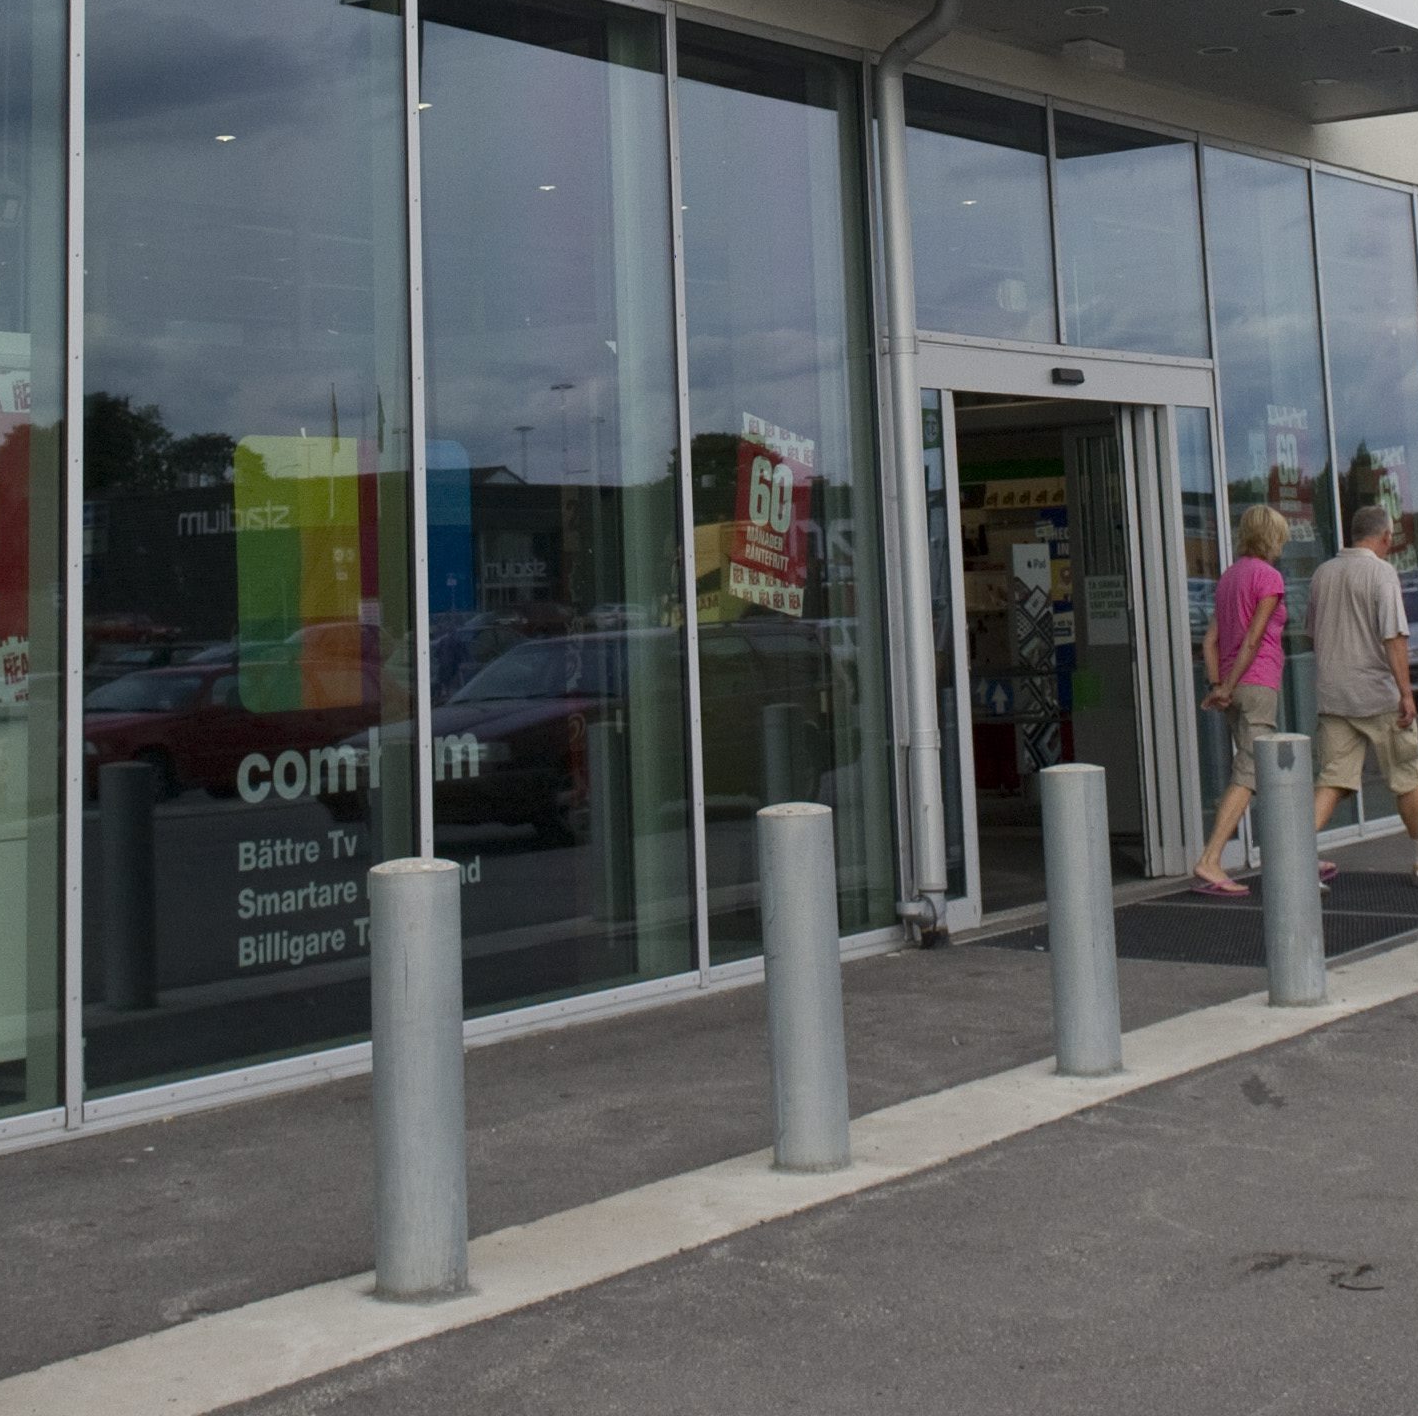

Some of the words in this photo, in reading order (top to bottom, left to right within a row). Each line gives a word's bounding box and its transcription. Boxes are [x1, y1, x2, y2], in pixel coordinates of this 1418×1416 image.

[748, 455, 793, 534] 60
[237, 744, 358, 804] com
[238, 838, 320, 872] Bättre
[328, 830, 358, 860] Tv
[237, 880, 358, 920] Smartare
[238, 927, 346, 968] Billigare
